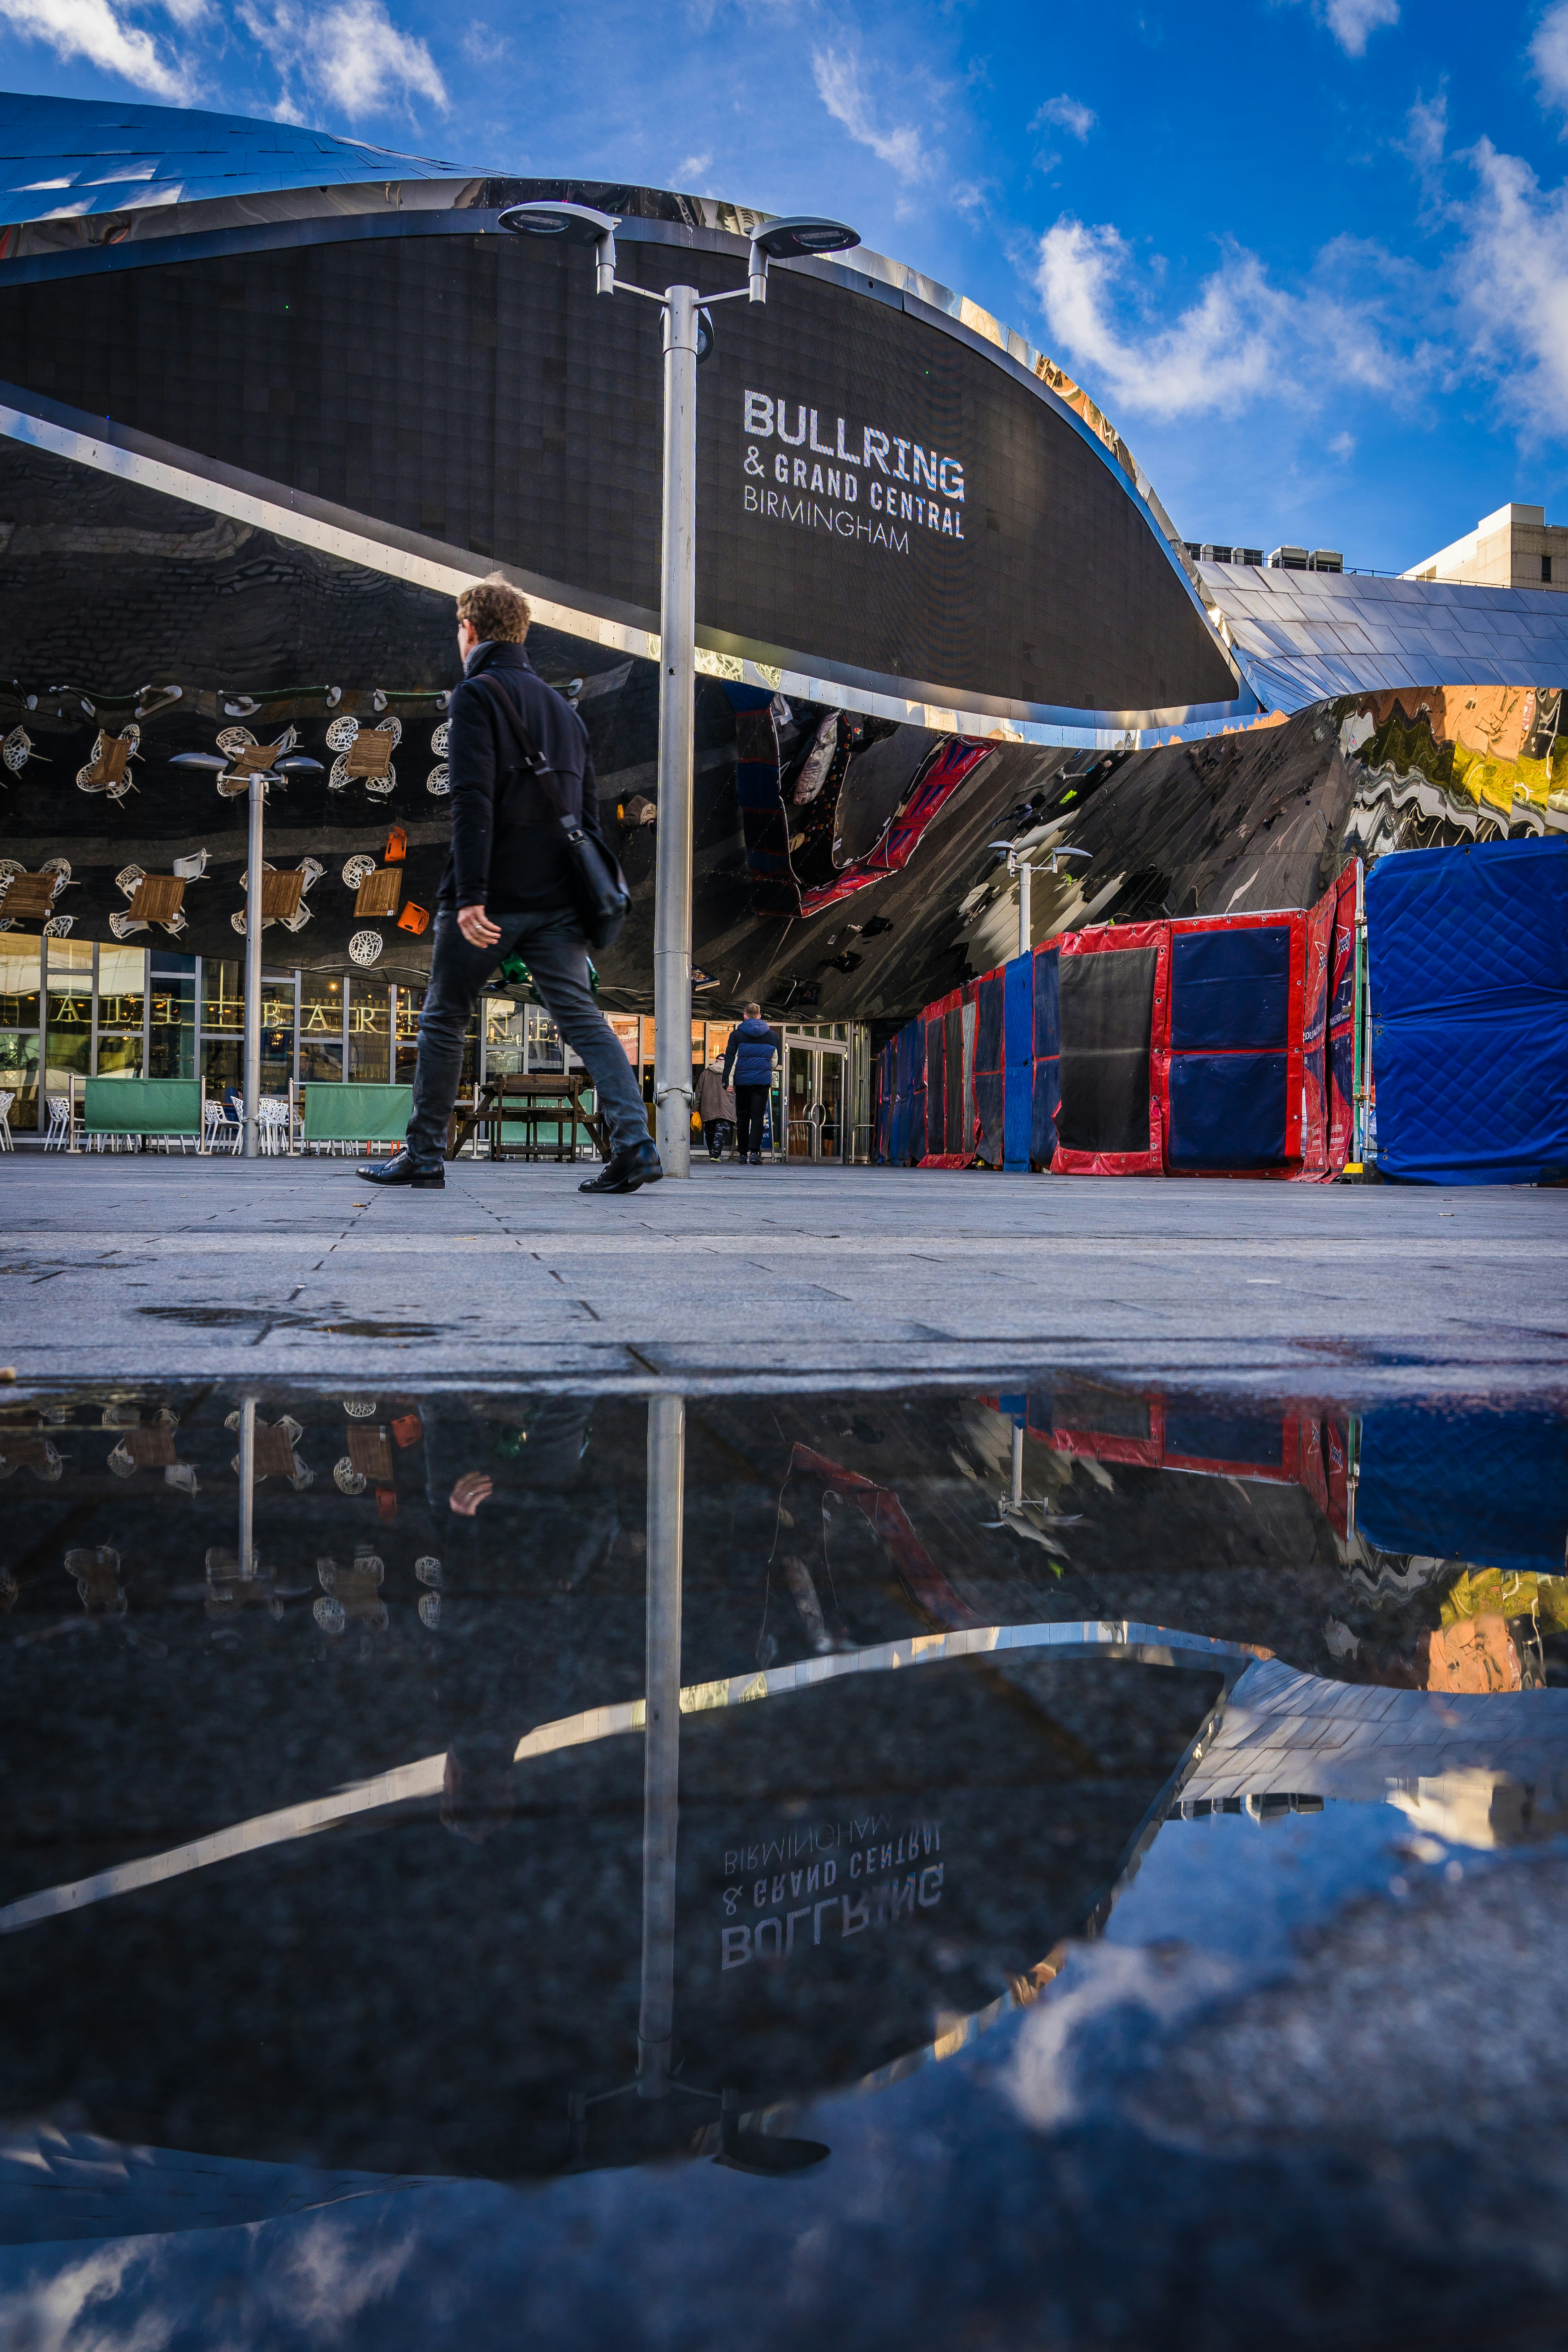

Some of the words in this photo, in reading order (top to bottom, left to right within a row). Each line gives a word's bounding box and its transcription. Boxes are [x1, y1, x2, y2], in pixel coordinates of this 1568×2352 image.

[744, 389, 965, 502] BULLRING
[744, 446, 765, 478] &
[775, 454, 858, 502] GRAND
[870, 482, 964, 540] CENTRAL
[744, 485, 909, 554] BIRMINGHAM
[55, 995, 182, 1024] ALL
[260, 1003, 382, 1034] BAR
